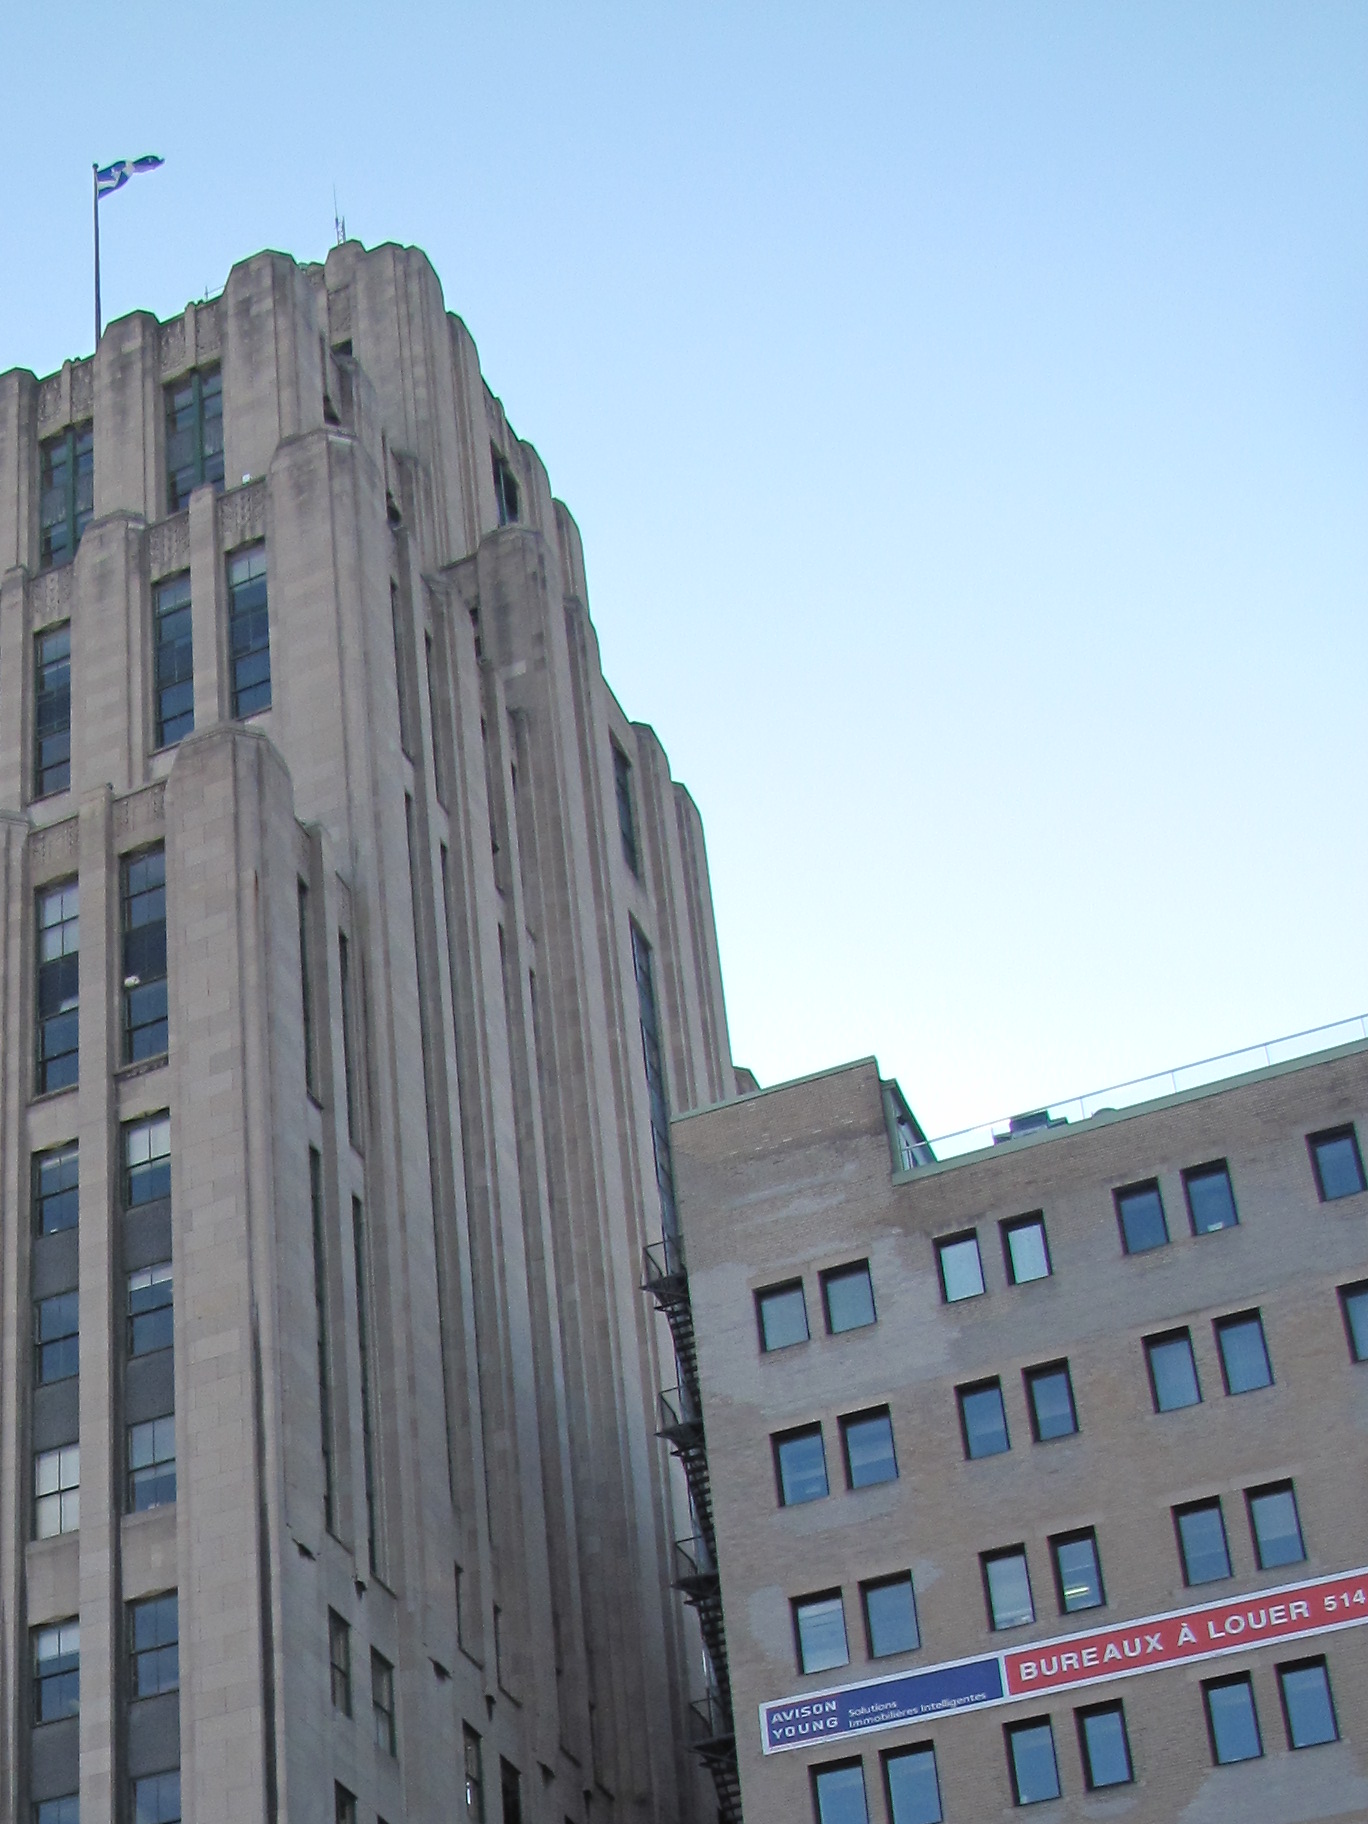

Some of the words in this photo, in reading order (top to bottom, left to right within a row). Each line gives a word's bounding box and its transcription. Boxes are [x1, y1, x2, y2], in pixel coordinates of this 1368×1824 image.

[1019, 1632, 1164, 1682] BUREAUX
[1177, 1623, 1198, 1647] À
[1207, 1600, 1310, 1640] LOUER
[1323, 1588, 1366, 1612] 514
[771, 1701, 837, 1724] AVISON
[848, 1701, 897, 1718] Solutions
[920, 1692, 988, 1713] Intelligentes
[772, 1717, 838, 1740] YOUNG
